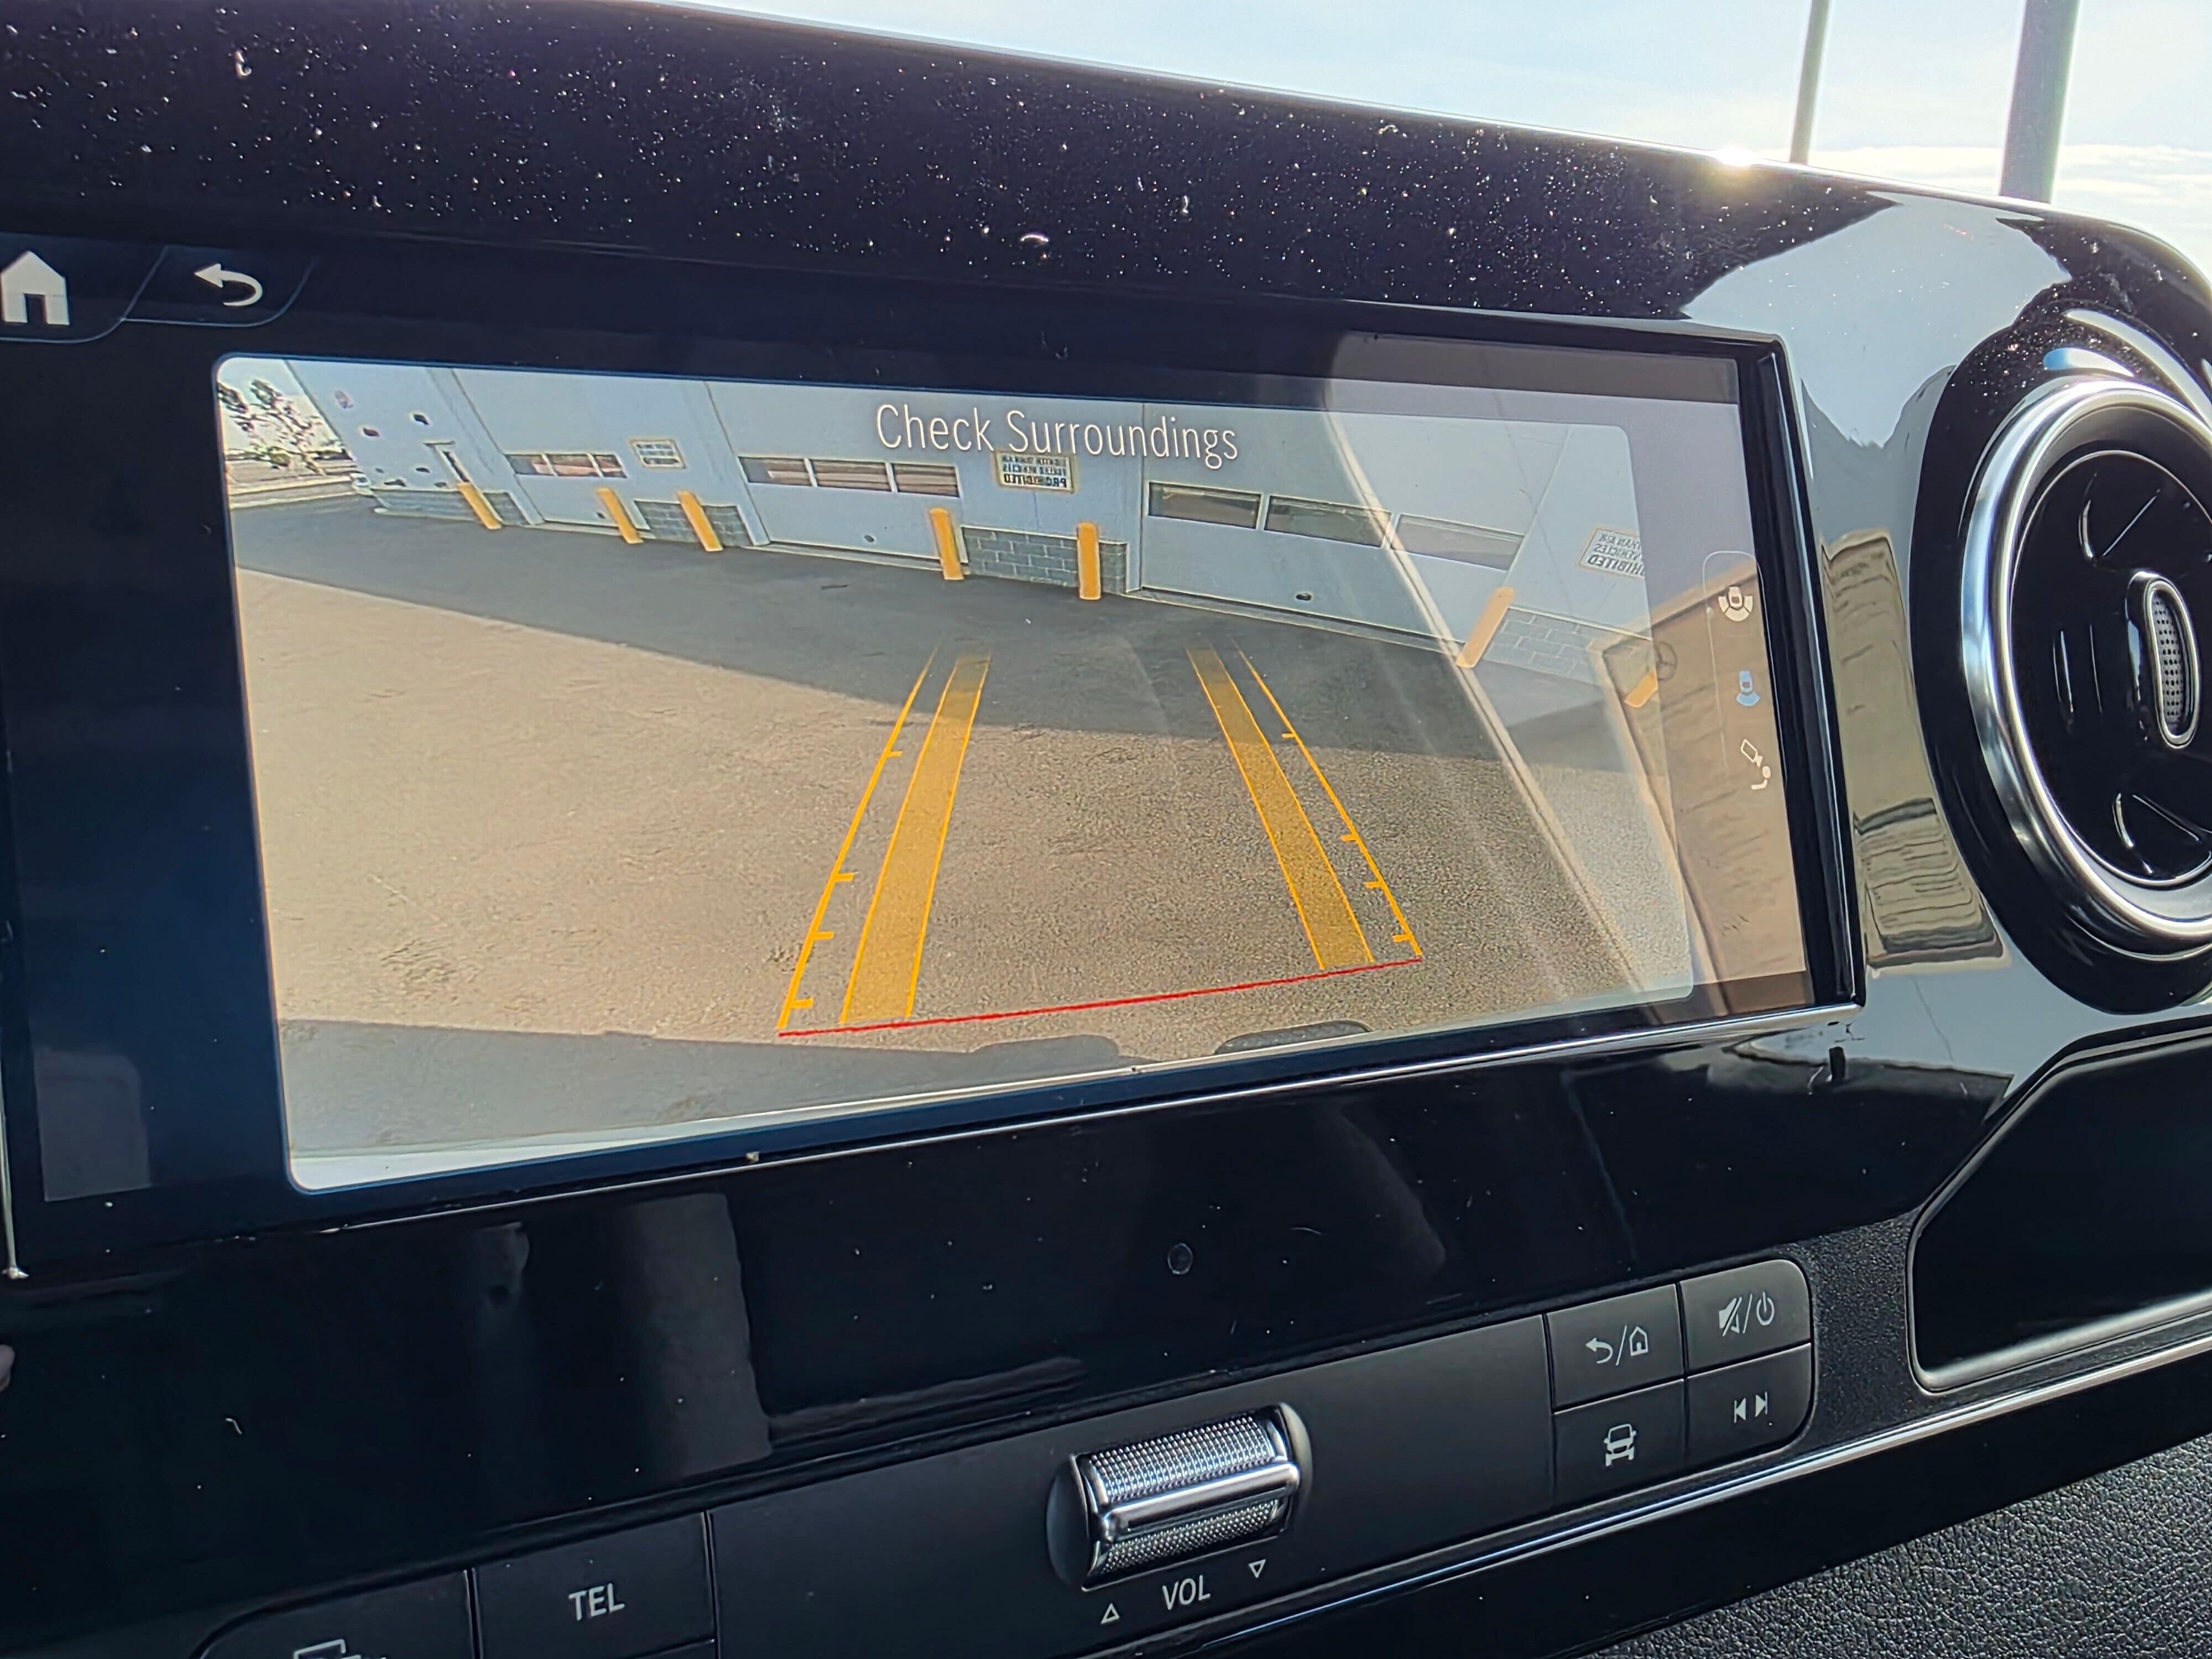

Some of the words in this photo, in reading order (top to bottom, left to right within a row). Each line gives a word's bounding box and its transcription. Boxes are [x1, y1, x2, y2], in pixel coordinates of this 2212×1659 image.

[877, 404, 994, 451] Check
[1008, 410, 1238, 469] Surroundings
[568, 1583, 625, 1621] TEL
[1162, 1575, 1211, 1610] VOL
